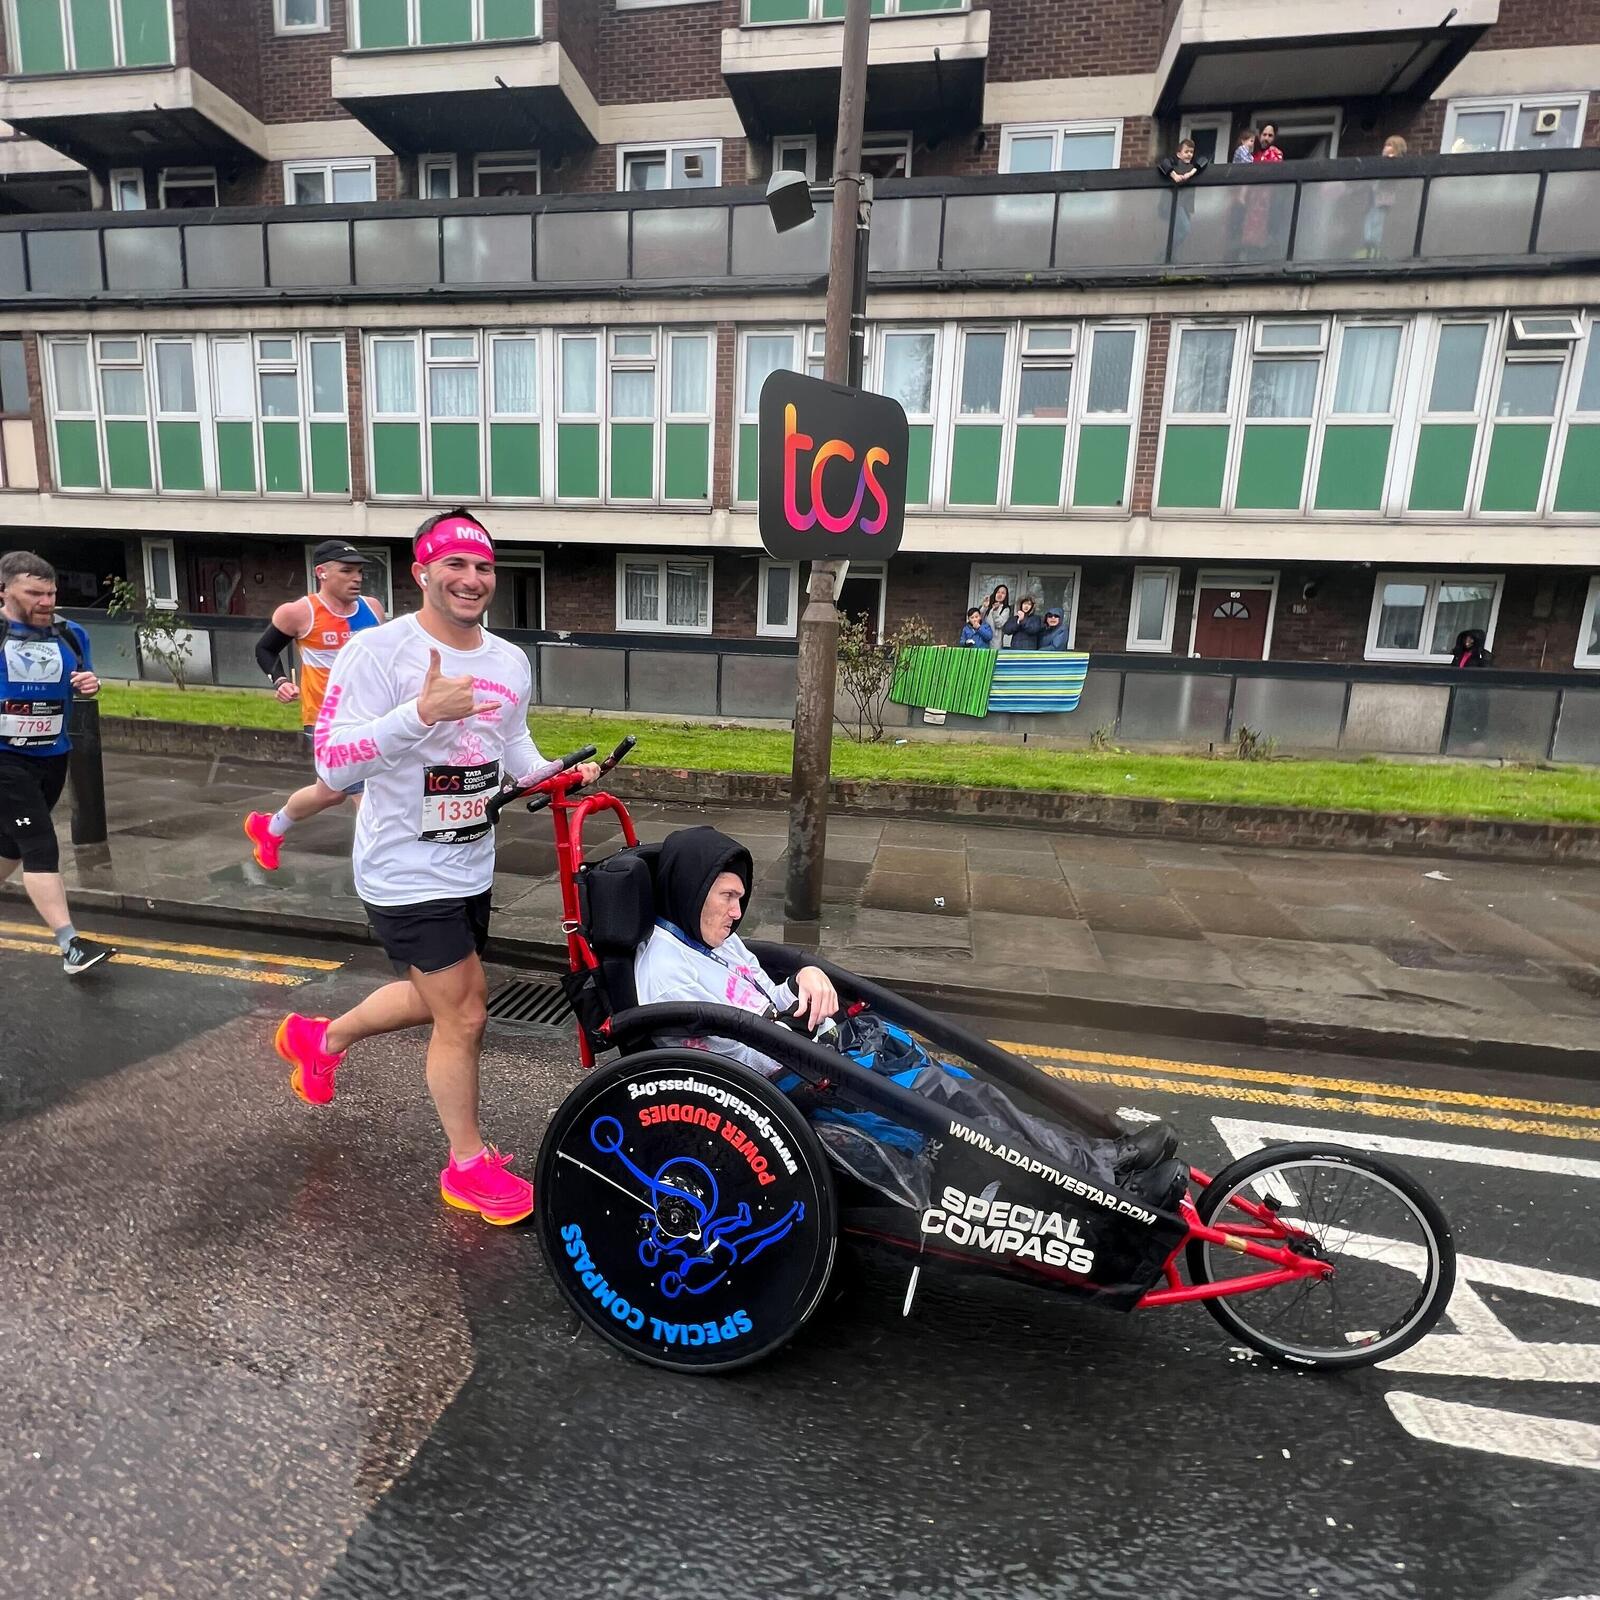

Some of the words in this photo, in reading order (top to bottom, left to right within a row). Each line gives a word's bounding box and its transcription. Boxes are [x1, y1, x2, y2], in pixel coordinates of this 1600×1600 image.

[783, 403, 890, 535] tcs
[17, 720, 52, 733] 7792
[429, 771, 461, 792] tcs
[464, 769, 482, 778] TATA
[638, 1103, 721, 1131] BUDDIES
[720, 1119, 776, 1186] POWER
[949, 1120, 1158, 1226] WWW.ADAPTIVESTAR.COM
[920, 1208, 1095, 1274] COMPASS
[940, 1186, 1086, 1246] SPECIAL
[561, 1223, 646, 1330] COMPASS
[649, 1309, 753, 1345] SPECIAL
